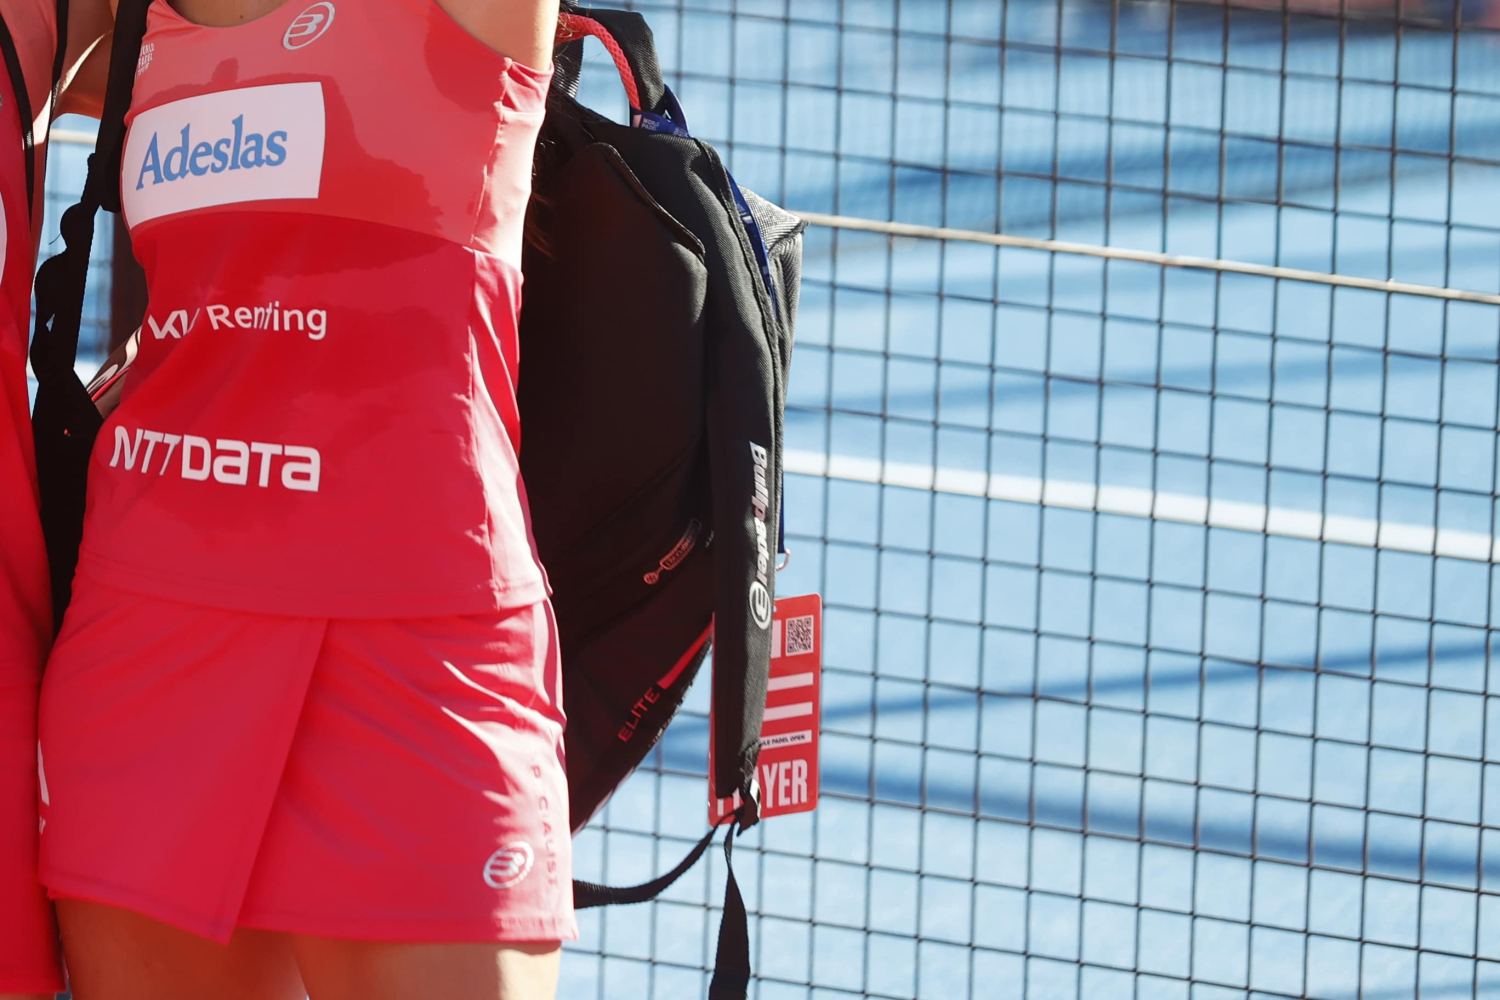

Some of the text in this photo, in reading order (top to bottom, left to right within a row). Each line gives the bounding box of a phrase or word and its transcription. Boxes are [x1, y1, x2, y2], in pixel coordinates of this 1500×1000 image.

[136, 114, 288, 191] Adeslas
[206, 300, 327, 340] Renting
[109, 425, 182, 476] NTT
[617, 686, 661, 743] ELITE
